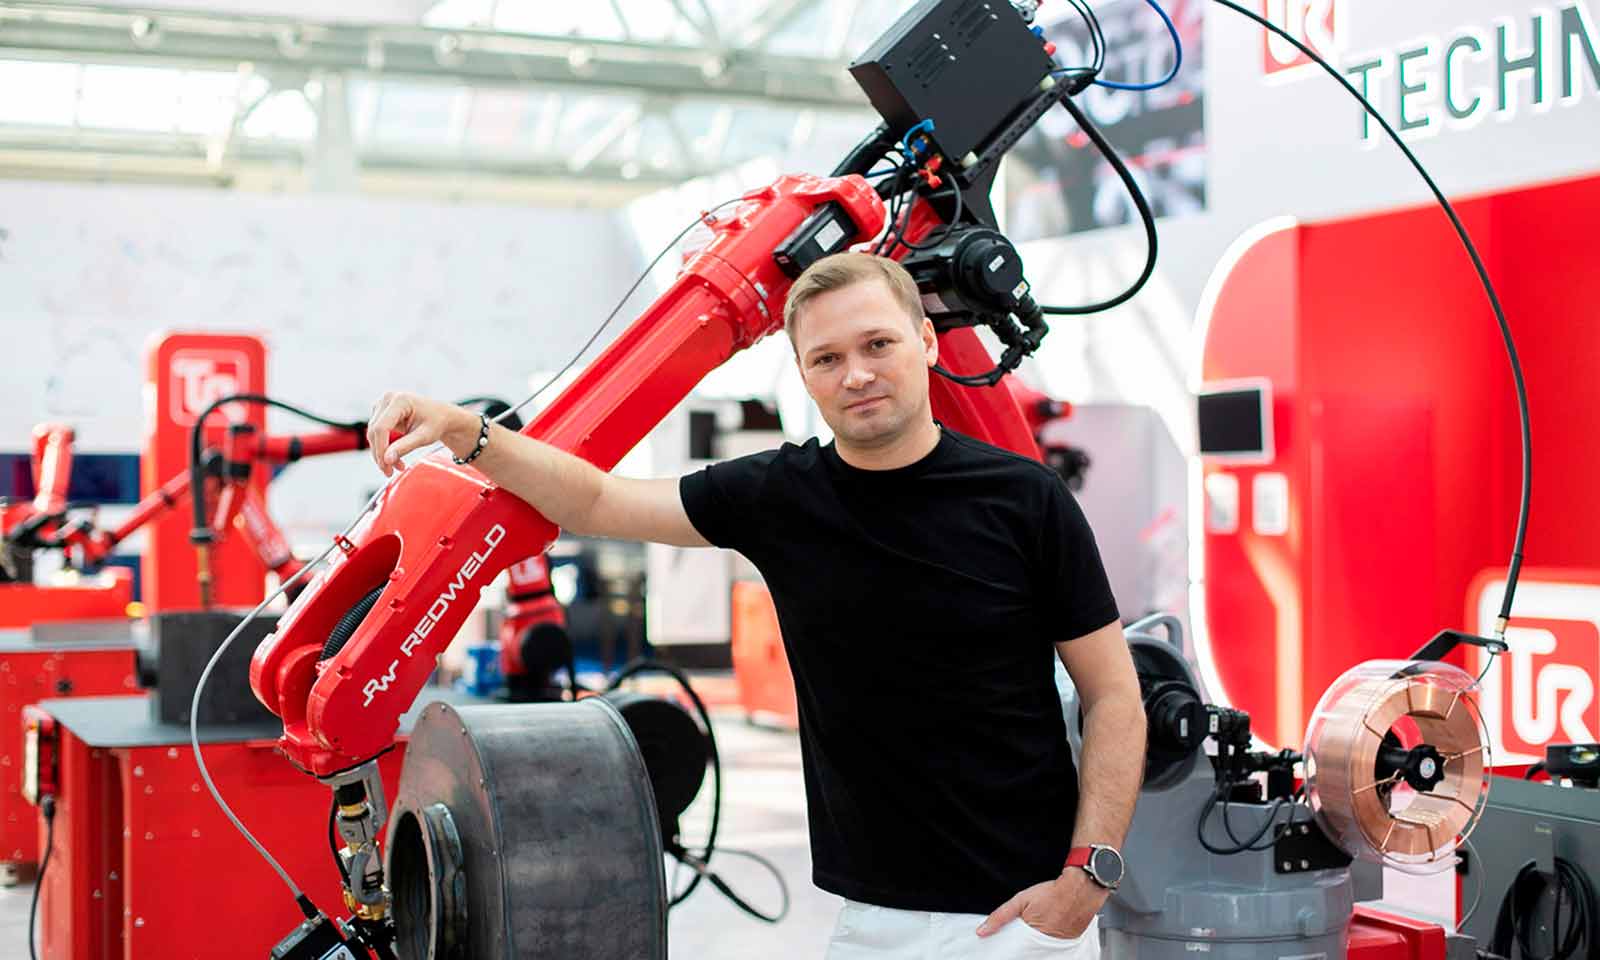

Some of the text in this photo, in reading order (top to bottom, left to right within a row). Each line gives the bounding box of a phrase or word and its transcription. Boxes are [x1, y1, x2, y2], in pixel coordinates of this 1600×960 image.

[1347, 5, 1600, 140] TECHN
[400, 523, 506, 657] REDWELD
[1502, 626, 1600, 746] TR
